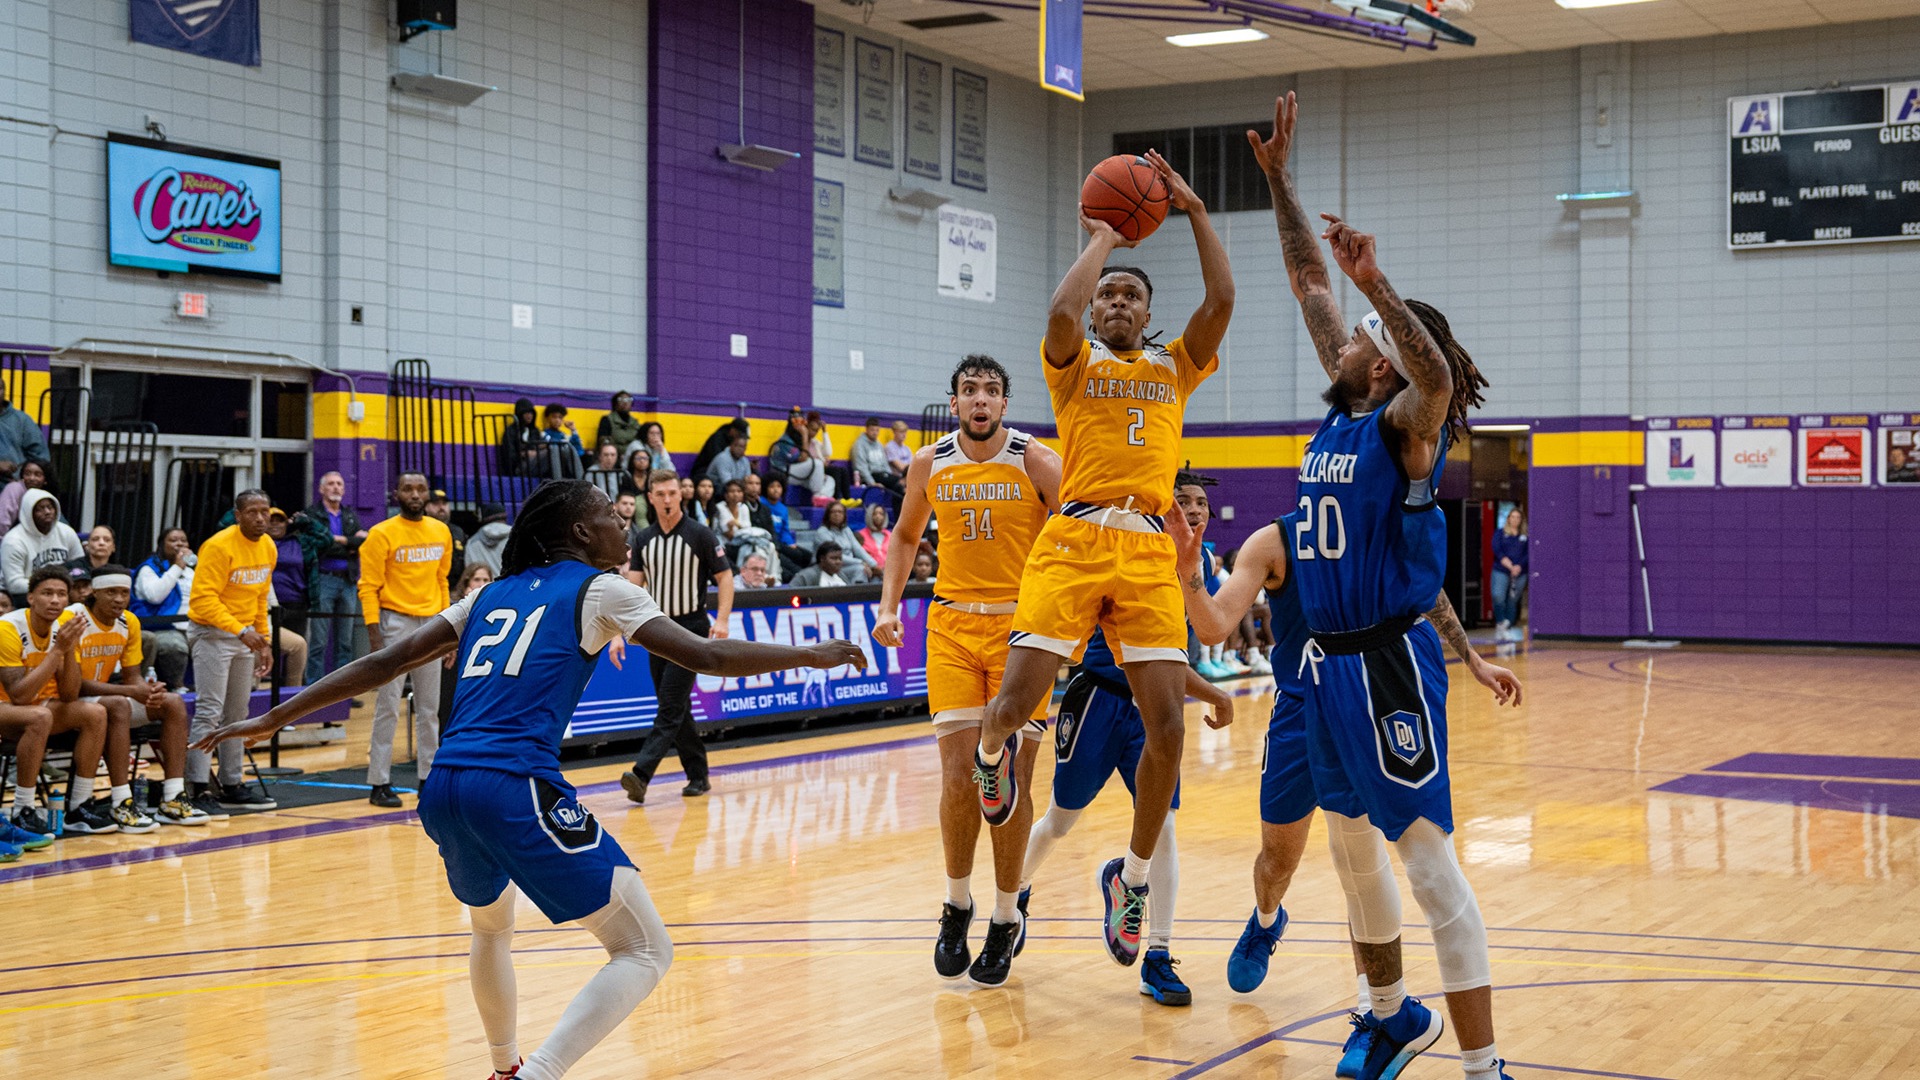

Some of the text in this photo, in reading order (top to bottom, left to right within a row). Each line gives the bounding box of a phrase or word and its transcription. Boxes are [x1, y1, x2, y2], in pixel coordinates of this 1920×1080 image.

[1742, 136, 1781, 154] LSUA
[1814, 139, 1852, 153] PERIOD
[183, 173, 227, 196] Raising
[1799, 183, 1869, 200] PLAYER FOUL
[139, 166, 262, 244] Cane's
[1732, 190, 1767, 204] FOULS
[181, 233, 249, 252] CHICKEN FINGERS
[1732, 231, 1767, 245] SCORE
[1814, 226, 1852, 240] MATCH
[184, 292, 206, 315] EXIT
[1083, 377, 1177, 405] ALEXANDRIA
[1127, 407, 1146, 446] 2
[1734, 449, 1769, 464] cicis
[936, 483, 1022, 502] ALEXANDRIA
[961, 508, 994, 541] 34
[1296, 495, 1347, 560] 20
[395, 549, 405, 562] AT
[461, 604, 547, 679] 21
[721, 681, 888, 713] HOME OF THE GENERALS
